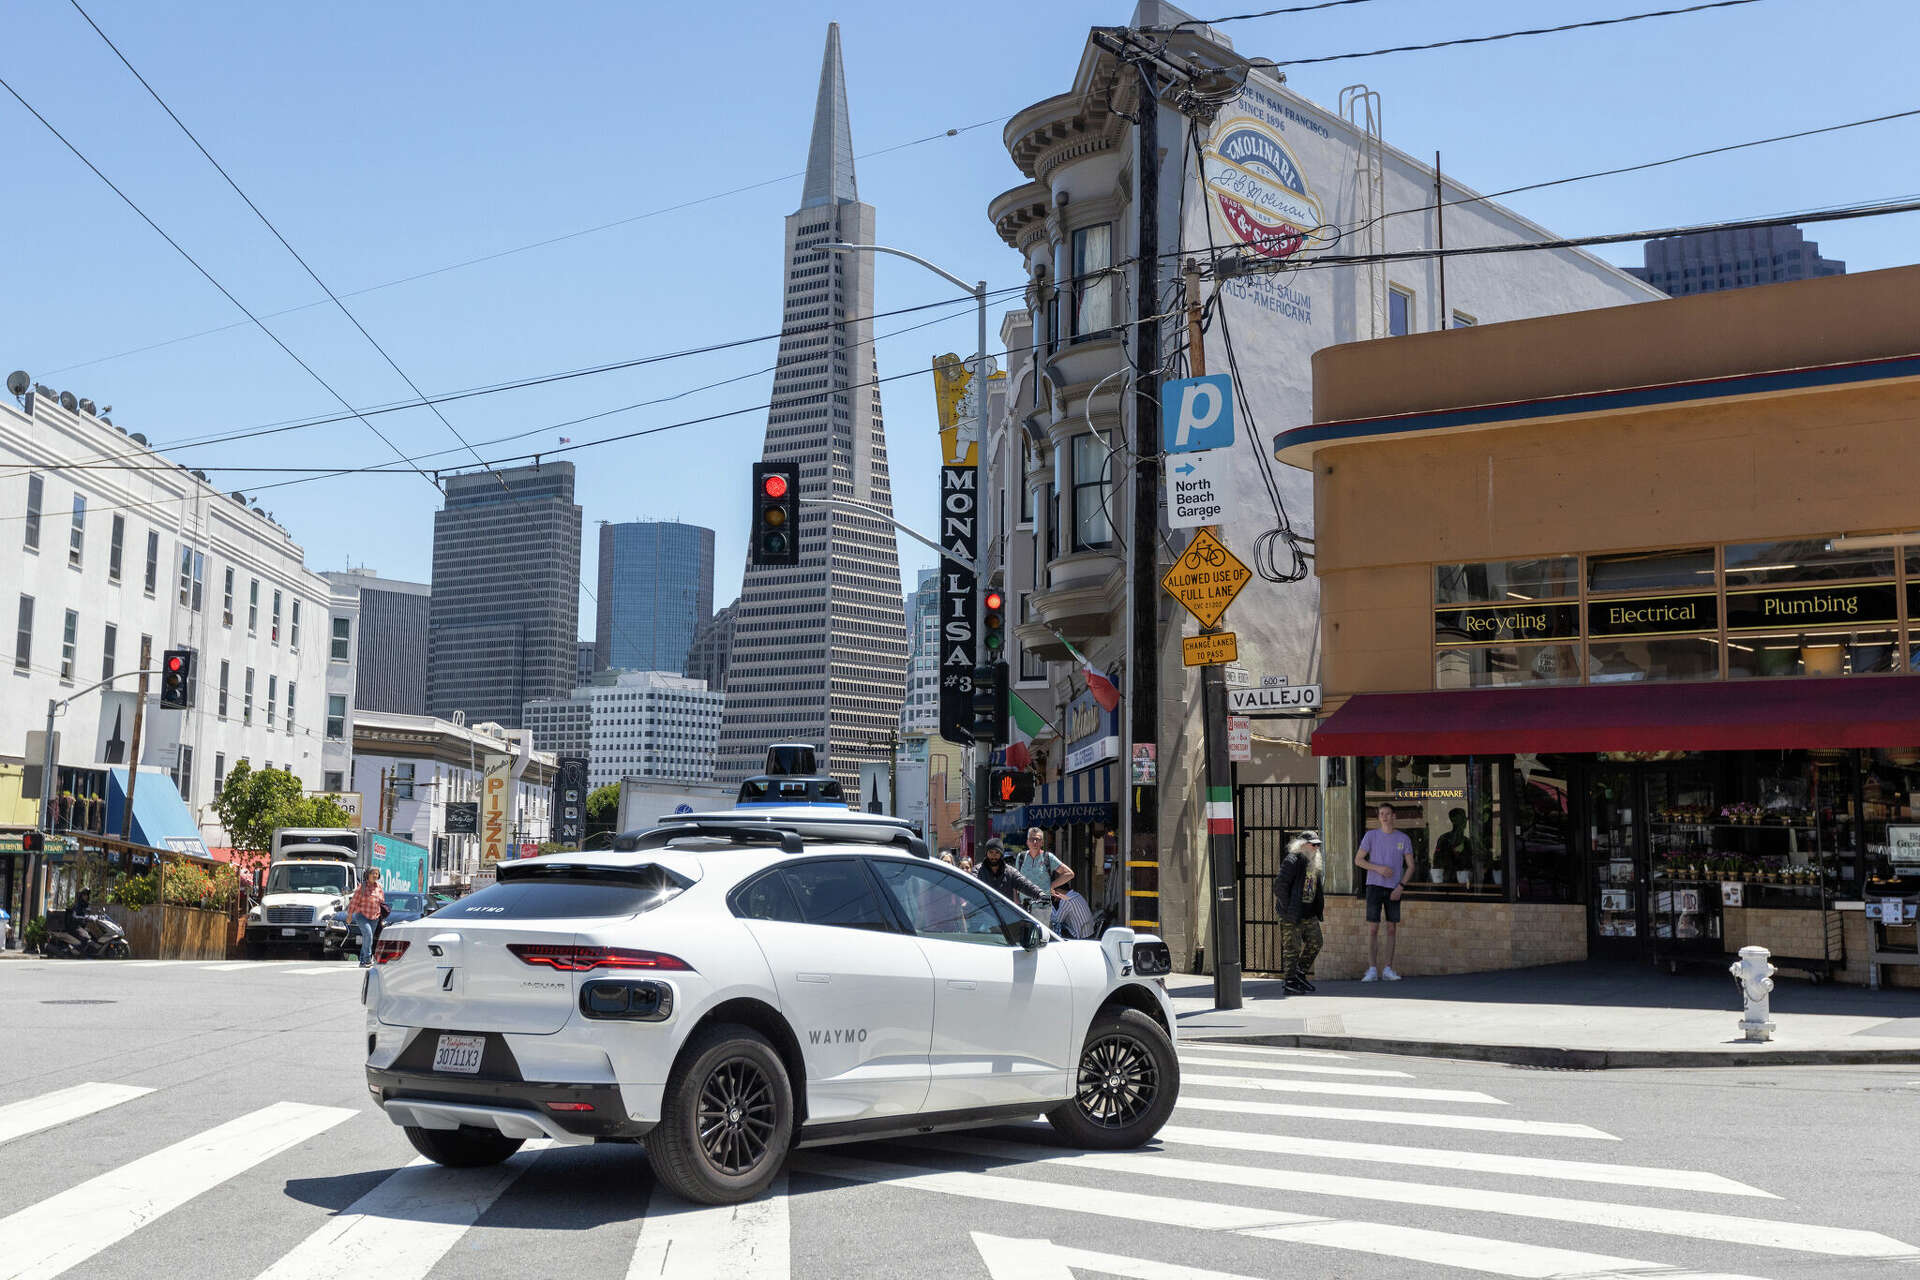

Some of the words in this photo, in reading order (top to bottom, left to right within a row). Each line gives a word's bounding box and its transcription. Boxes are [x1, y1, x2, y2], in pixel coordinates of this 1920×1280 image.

[1239, 99, 1264, 121] SINCE
[1266, 113, 1285, 132] 1896
[1255, 87, 1265, 105] IN
[1266, 95, 1283, 115] SAN
[1285, 106, 1329, 139] FRANCISCO
[1226, 136, 1297, 188] MOLINARI
[1237, 214, 1252, 235] &
[1276, 284, 1311, 310] SALUMI
[1176, 479, 1211, 492] North
[1176, 491, 1215, 505] Beach
[944, 470, 976, 560] MONA
[1177, 504, 1221, 517] Garage
[1168, 572, 1210, 587] ALLOWED
[1213, 570, 1231, 583] USE
[1233, 569, 1245, 581] OF
[1181, 588, 1205, 601] FULL
[1208, 585, 1234, 599] LANE
[1609, 602, 1696, 624] Electrical
[1764, 595, 1858, 615] Plumbing
[944, 573, 974, 666] LISA
[1465, 613, 1546, 635] Recycling
[1185, 640, 1211, 651] CHANGE
[1212, 637, 1234, 648] LANES
[1196, 651, 1205, 660] TO
[1206, 649, 1224, 659] PASS
[1263, 677, 1278, 687] 600
[1233, 689, 1315, 707] VALLEJO
[1398, 790, 1419, 798] COLE
[1421, 789, 1464, 798] HARDWARE
[484, 778, 505, 859] PIZZA
[808, 1028, 868, 1045] WAYMO
[436, 1047, 479, 1067] 30711X3
